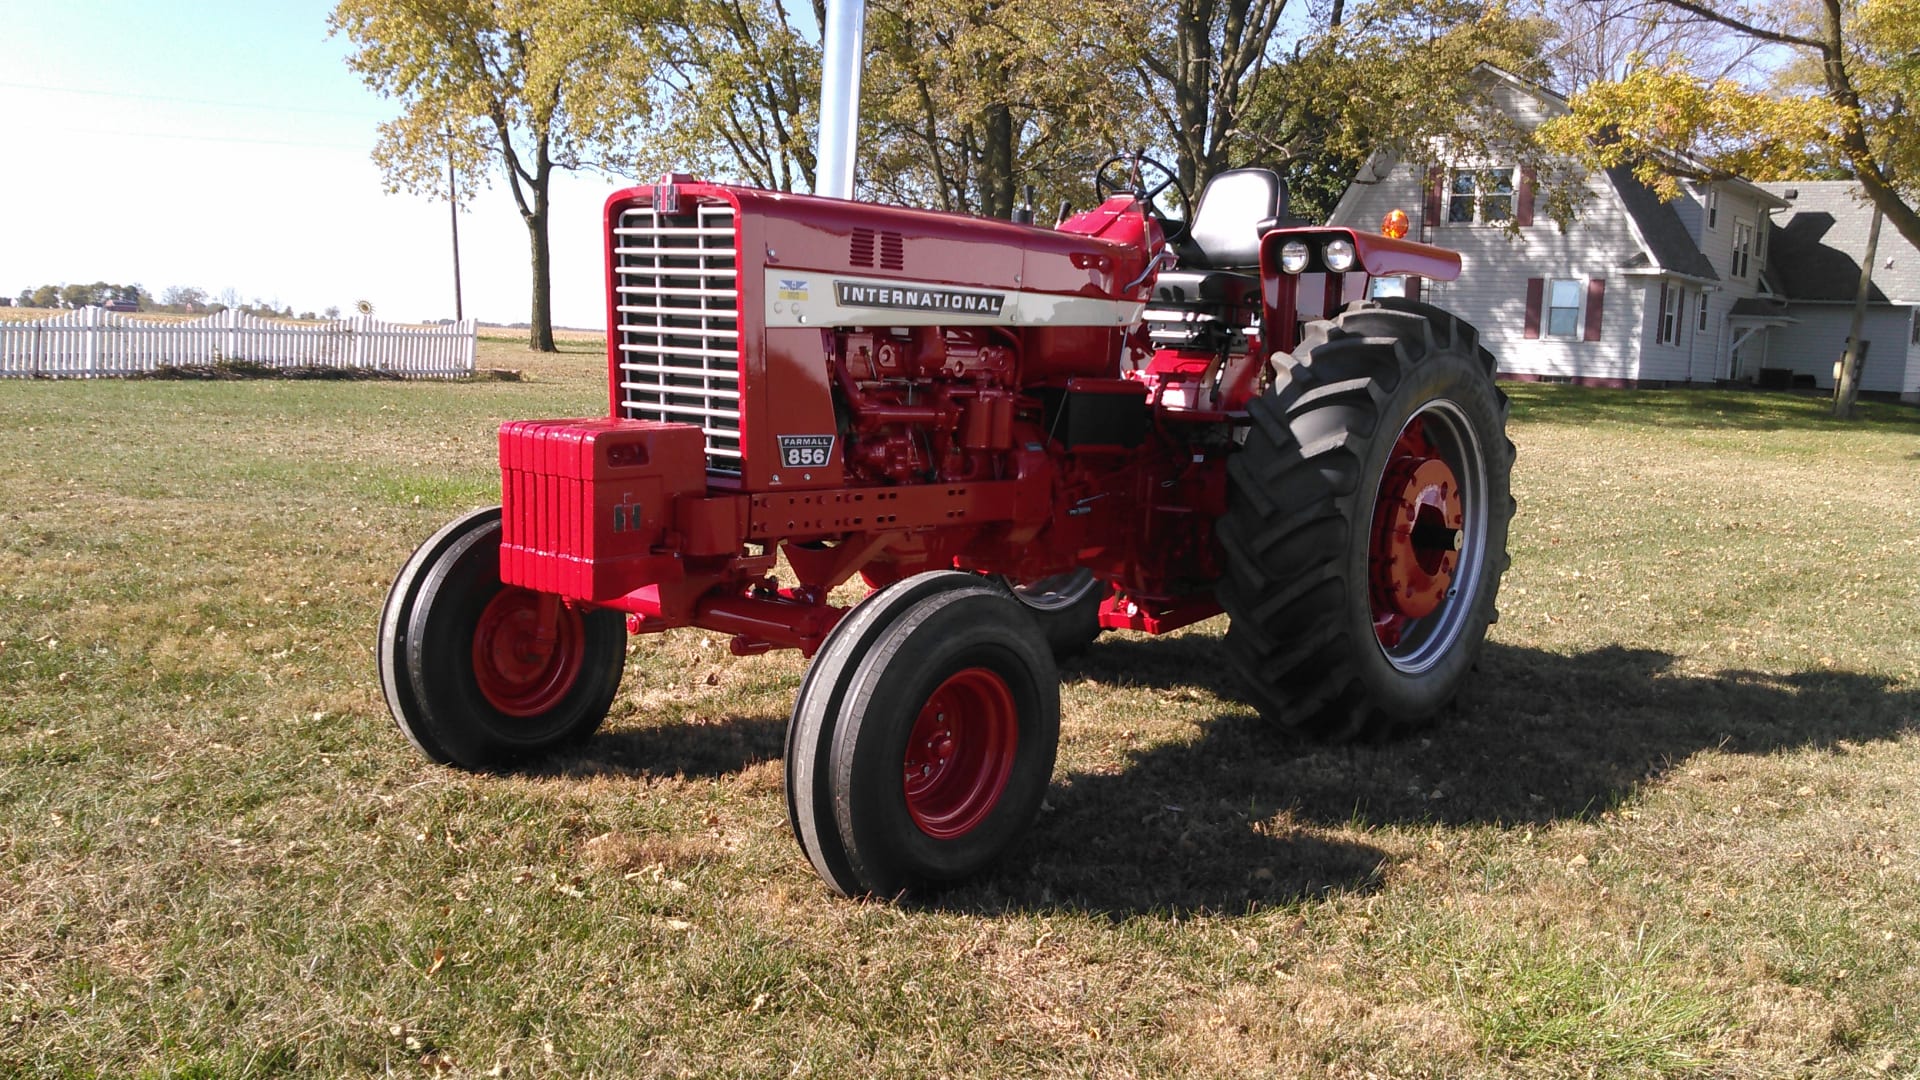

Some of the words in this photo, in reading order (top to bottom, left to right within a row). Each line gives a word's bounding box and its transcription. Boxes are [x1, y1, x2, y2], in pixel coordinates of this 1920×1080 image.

[843, 286, 1000, 312] INTERNATIONAL
[784, 438, 828, 446] FARMALL
[788, 448, 825, 465] 856
